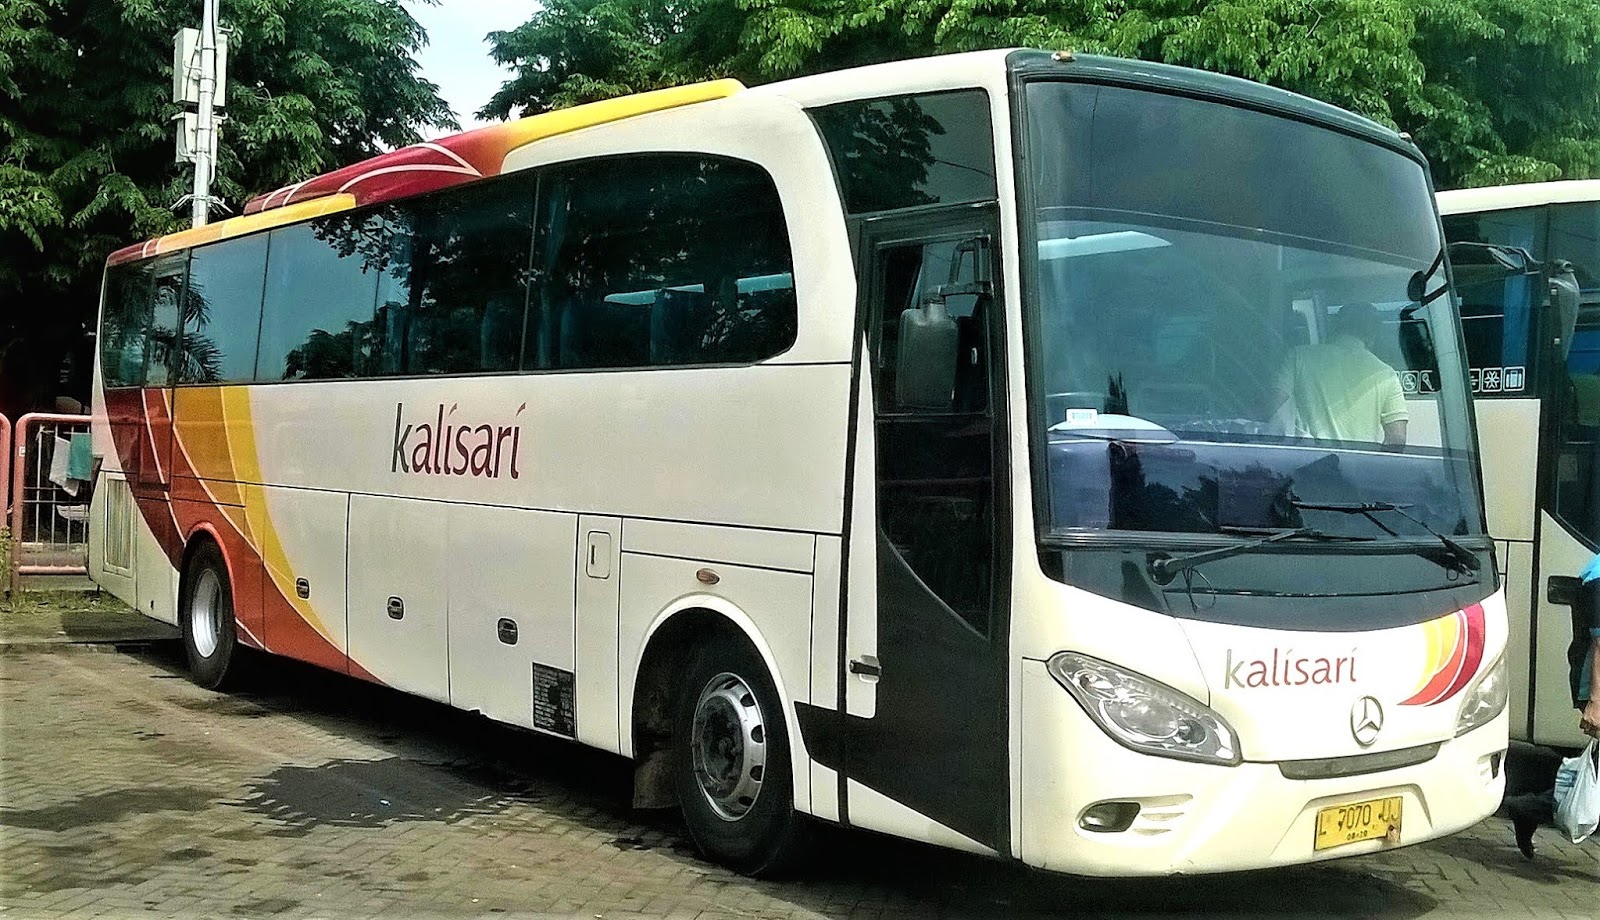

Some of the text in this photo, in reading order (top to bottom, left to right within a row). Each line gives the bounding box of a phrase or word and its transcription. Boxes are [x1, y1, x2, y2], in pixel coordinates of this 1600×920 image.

[391, 401, 526, 480] kalisari
[1225, 647, 1358, 690] kalisari
[1318, 812, 1327, 836] L
[1337, 803, 1372, 832] 7070
